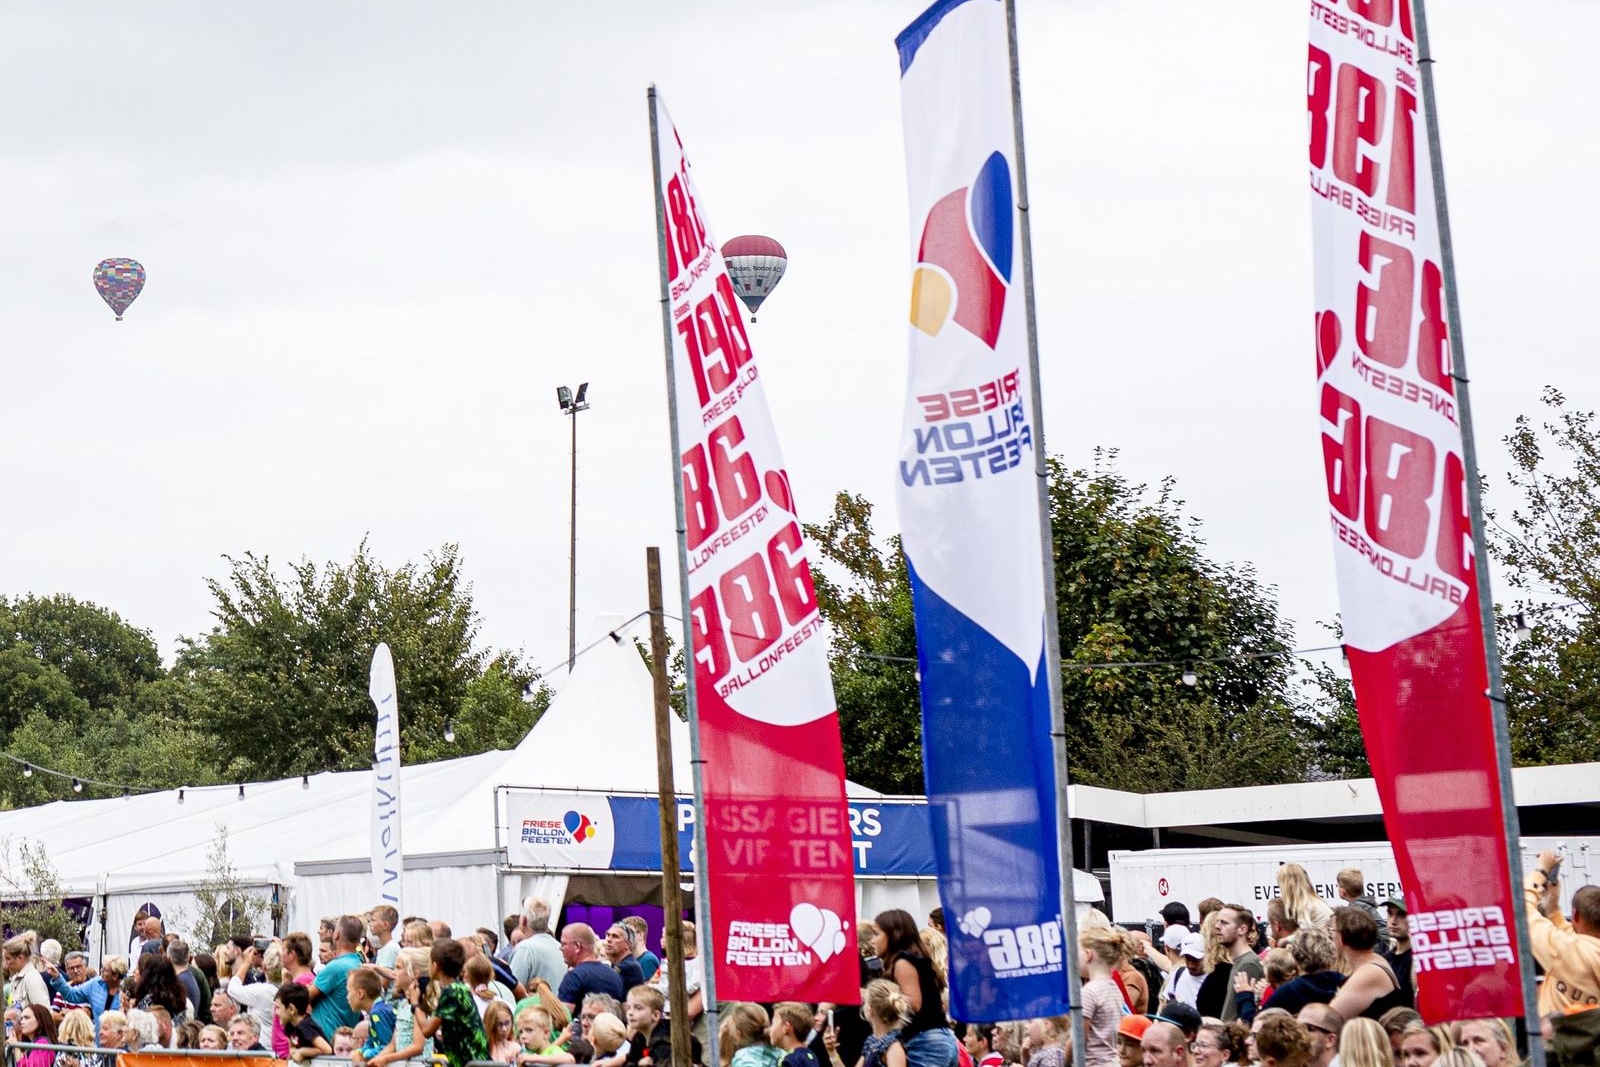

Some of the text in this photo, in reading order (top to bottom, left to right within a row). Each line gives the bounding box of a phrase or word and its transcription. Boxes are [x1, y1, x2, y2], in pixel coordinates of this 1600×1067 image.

[522, 820, 562, 829] FRIESE
[521, 828, 566, 837] BALLON
[520, 836, 571, 845] FEESTEN
[729, 920, 790, 938] FRIESE
[727, 936, 798, 952] BALLON
[725, 951, 811, 966] FEESTEN
